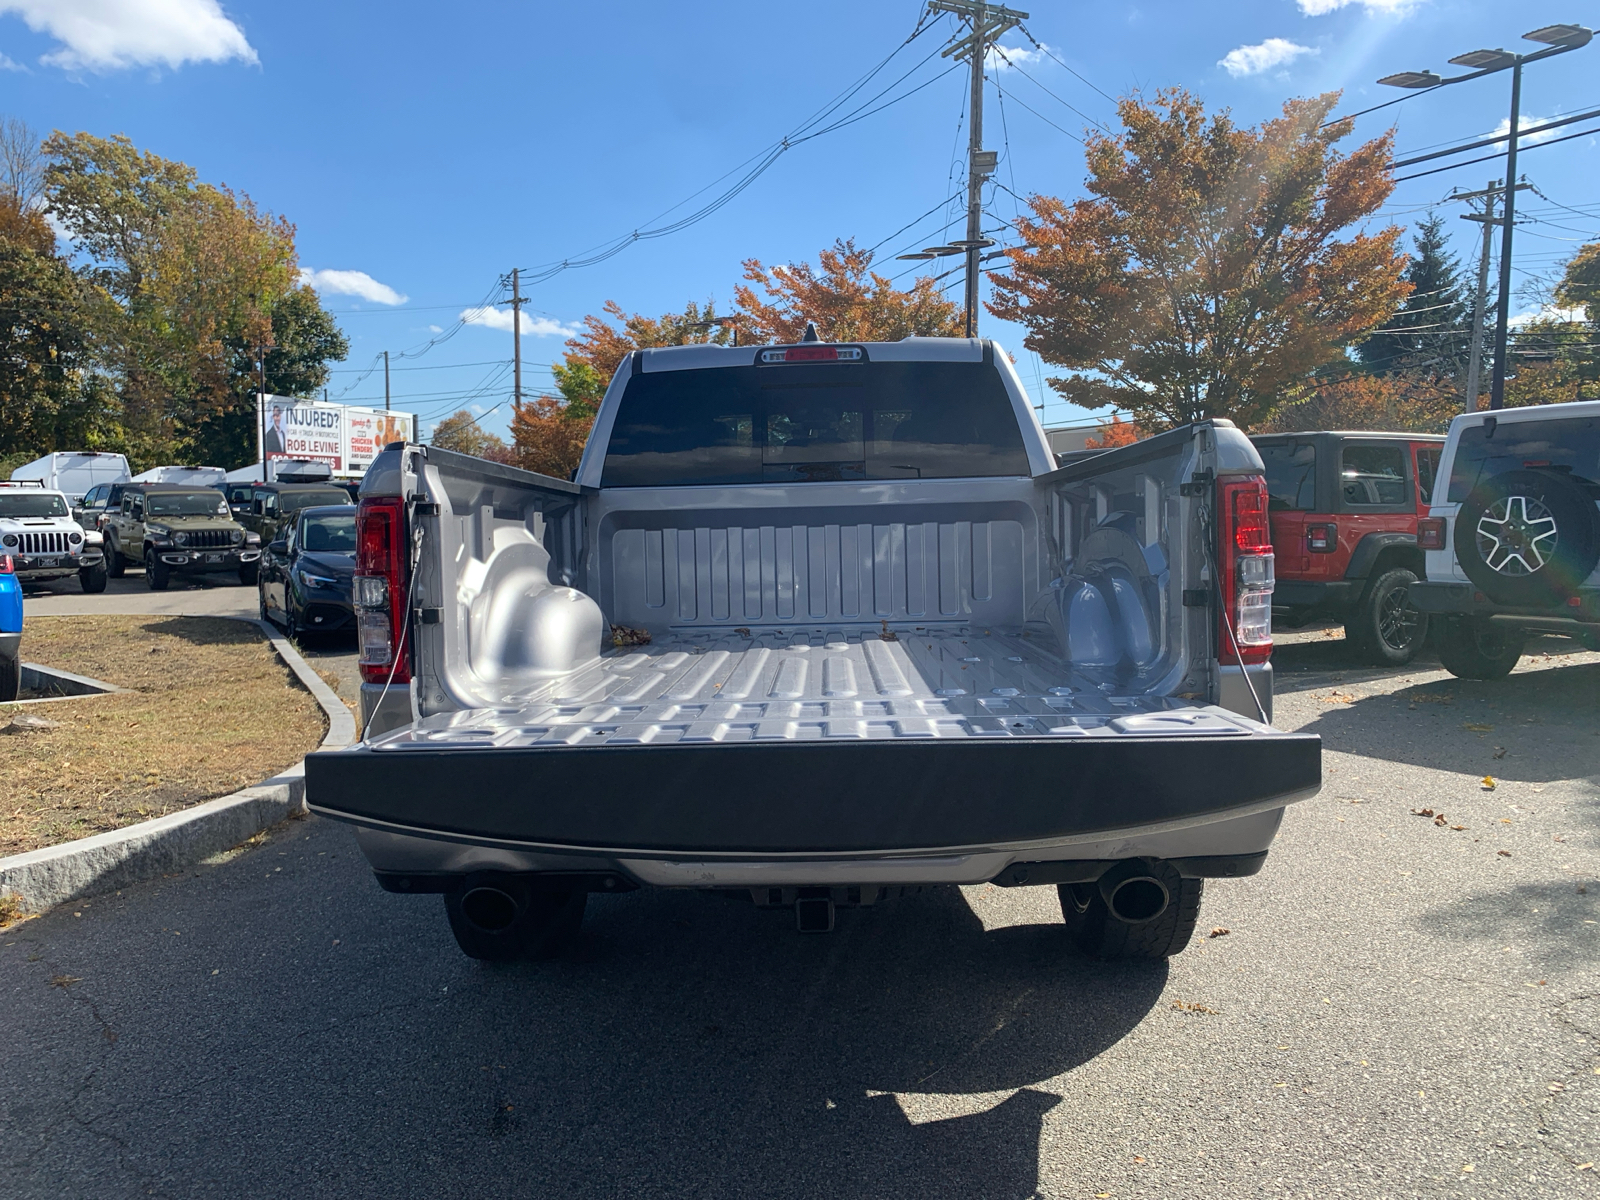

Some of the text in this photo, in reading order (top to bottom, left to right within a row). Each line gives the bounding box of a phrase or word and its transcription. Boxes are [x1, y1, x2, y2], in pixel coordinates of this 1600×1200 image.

[286, 407, 340, 429] INJURED?
[287, 439, 339, 454] ROB LEVINE
[351, 437, 373, 445] CHICKEN
[351, 445, 373, 453] TENDERS
